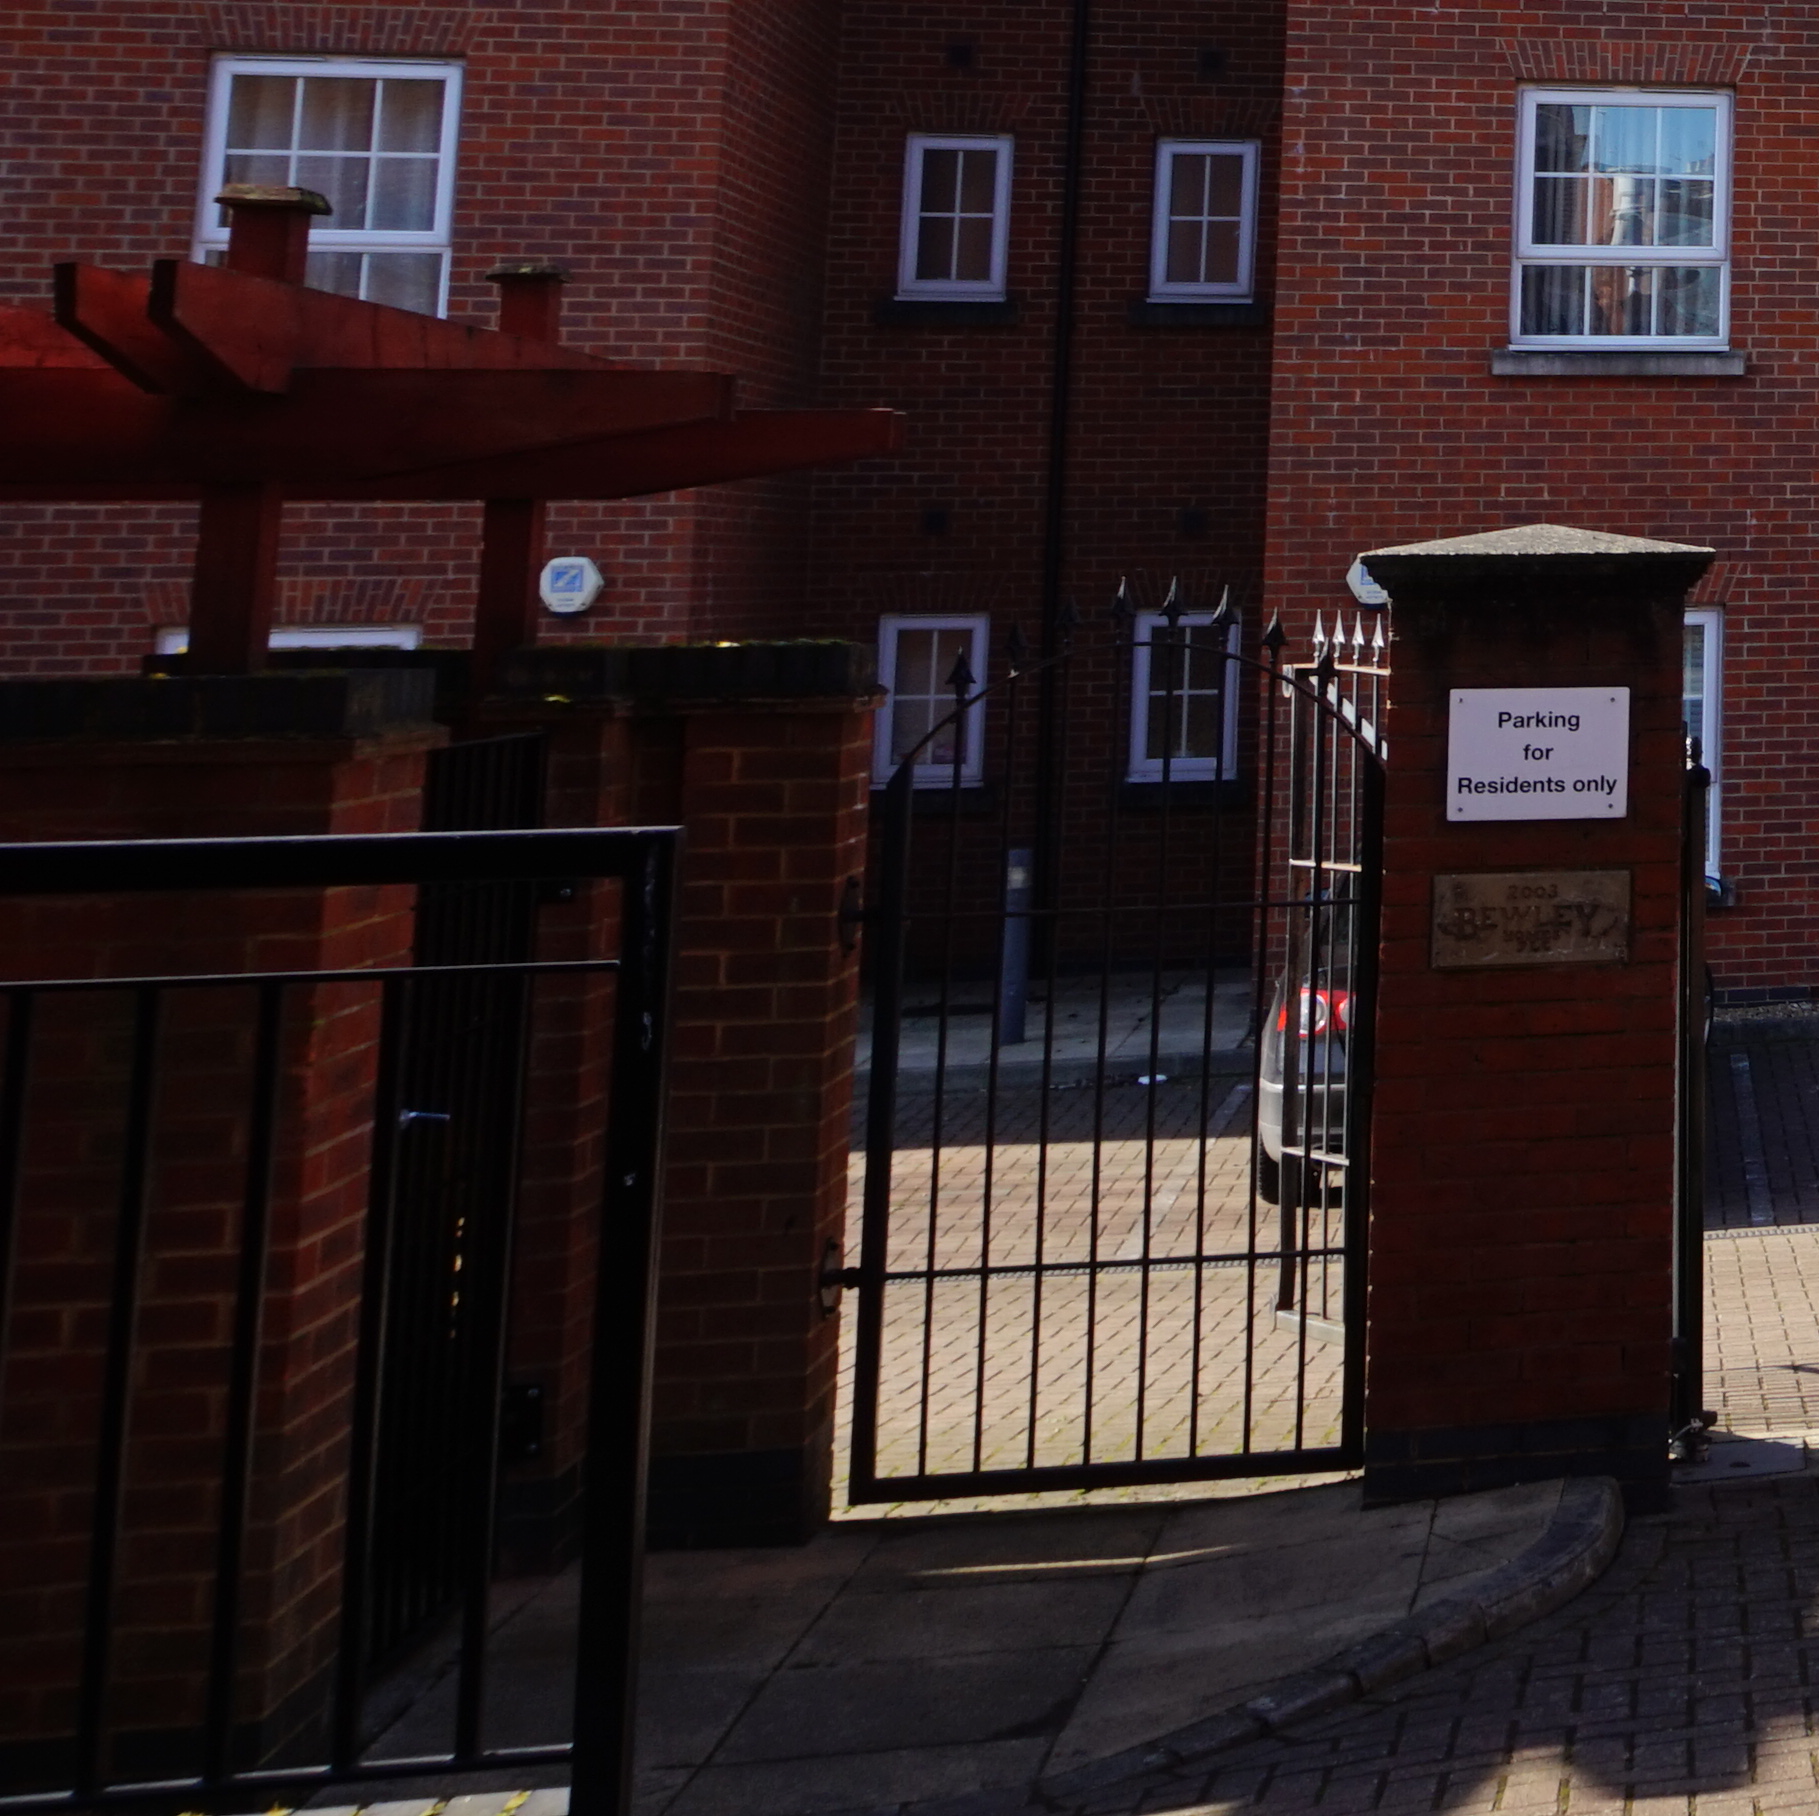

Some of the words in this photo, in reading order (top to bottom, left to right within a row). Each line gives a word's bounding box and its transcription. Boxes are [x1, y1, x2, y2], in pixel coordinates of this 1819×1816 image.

[1498, 711, 1580, 732] Parking
[1523, 744, 1554, 761] for
[1458, 776, 1566, 794] Residents
[1572, 775, 1618, 796] only
[1507, 884, 1559, 900] 2003
[1450, 904, 1602, 941] BEWLEY
